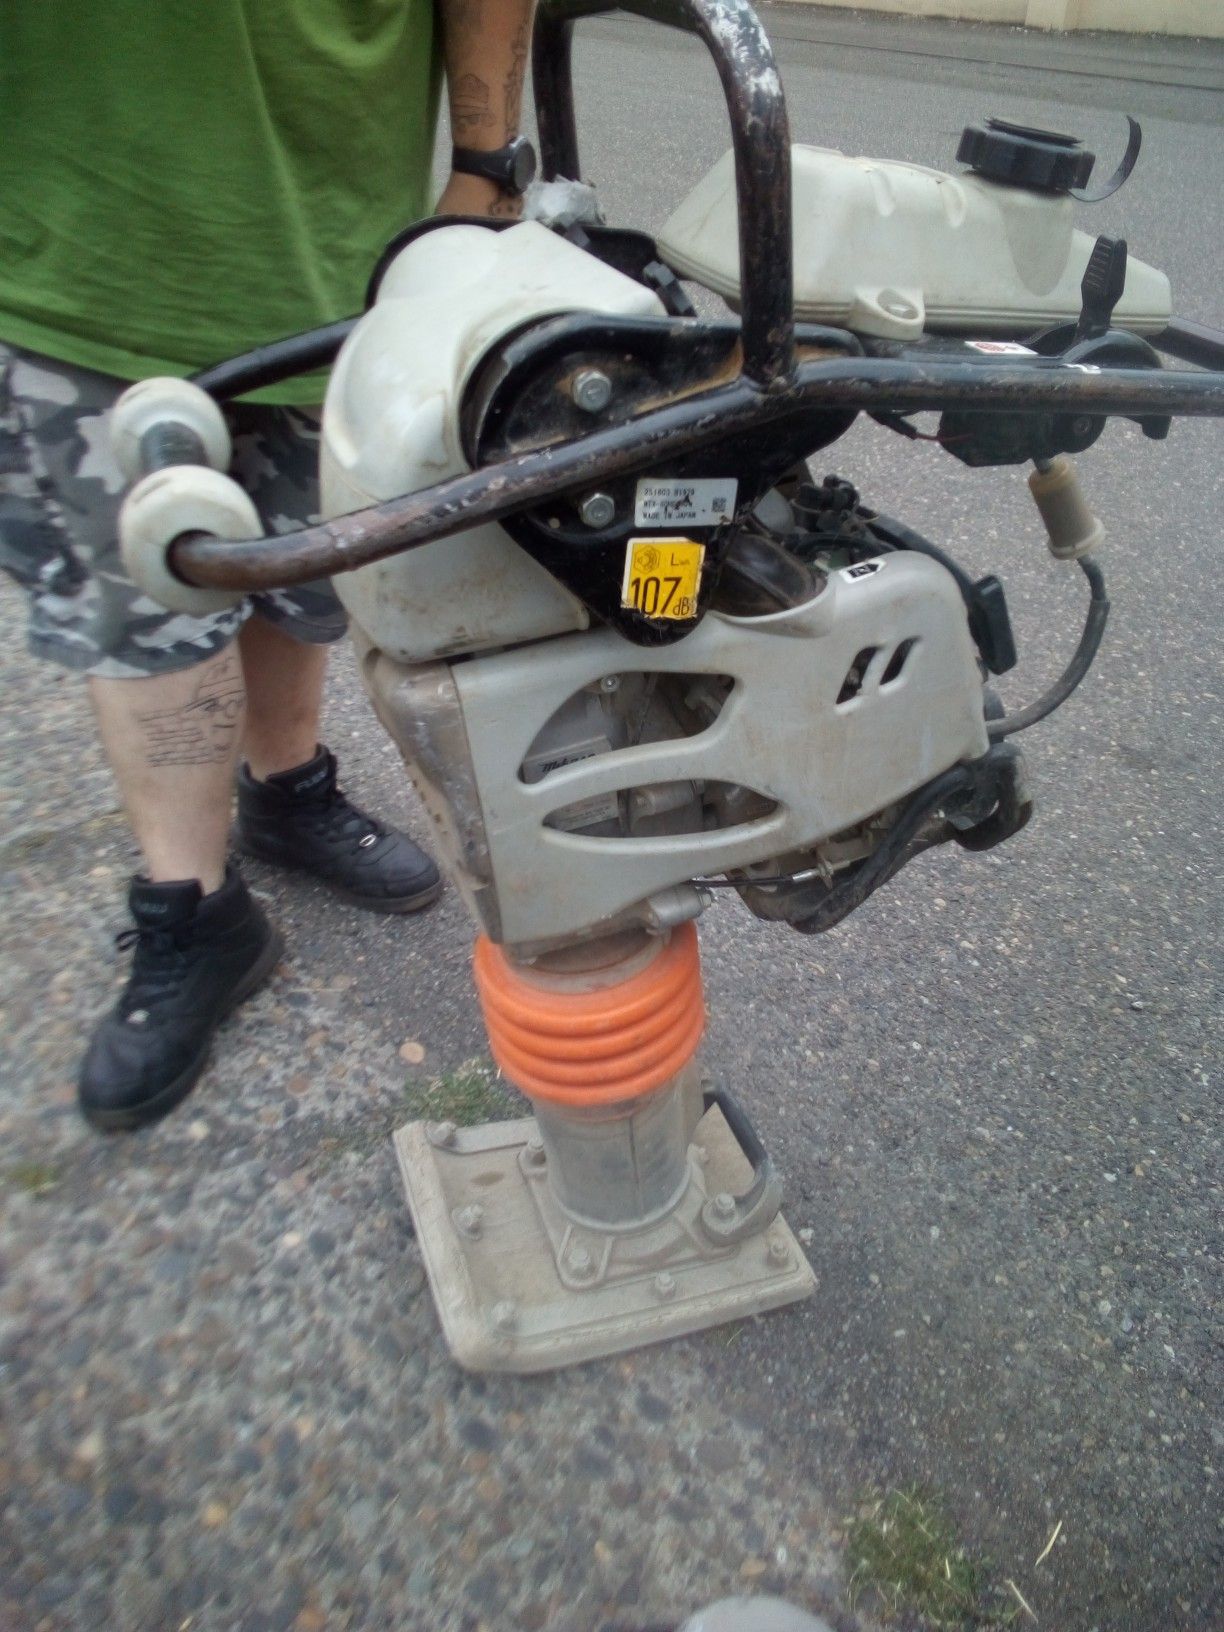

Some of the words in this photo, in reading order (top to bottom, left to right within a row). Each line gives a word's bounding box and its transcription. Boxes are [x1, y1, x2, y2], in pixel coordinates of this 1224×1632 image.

[675, 511, 697, 519] JAPAN
[631, 576, 683, 616] 107
[672, 597, 690, 616] dB
